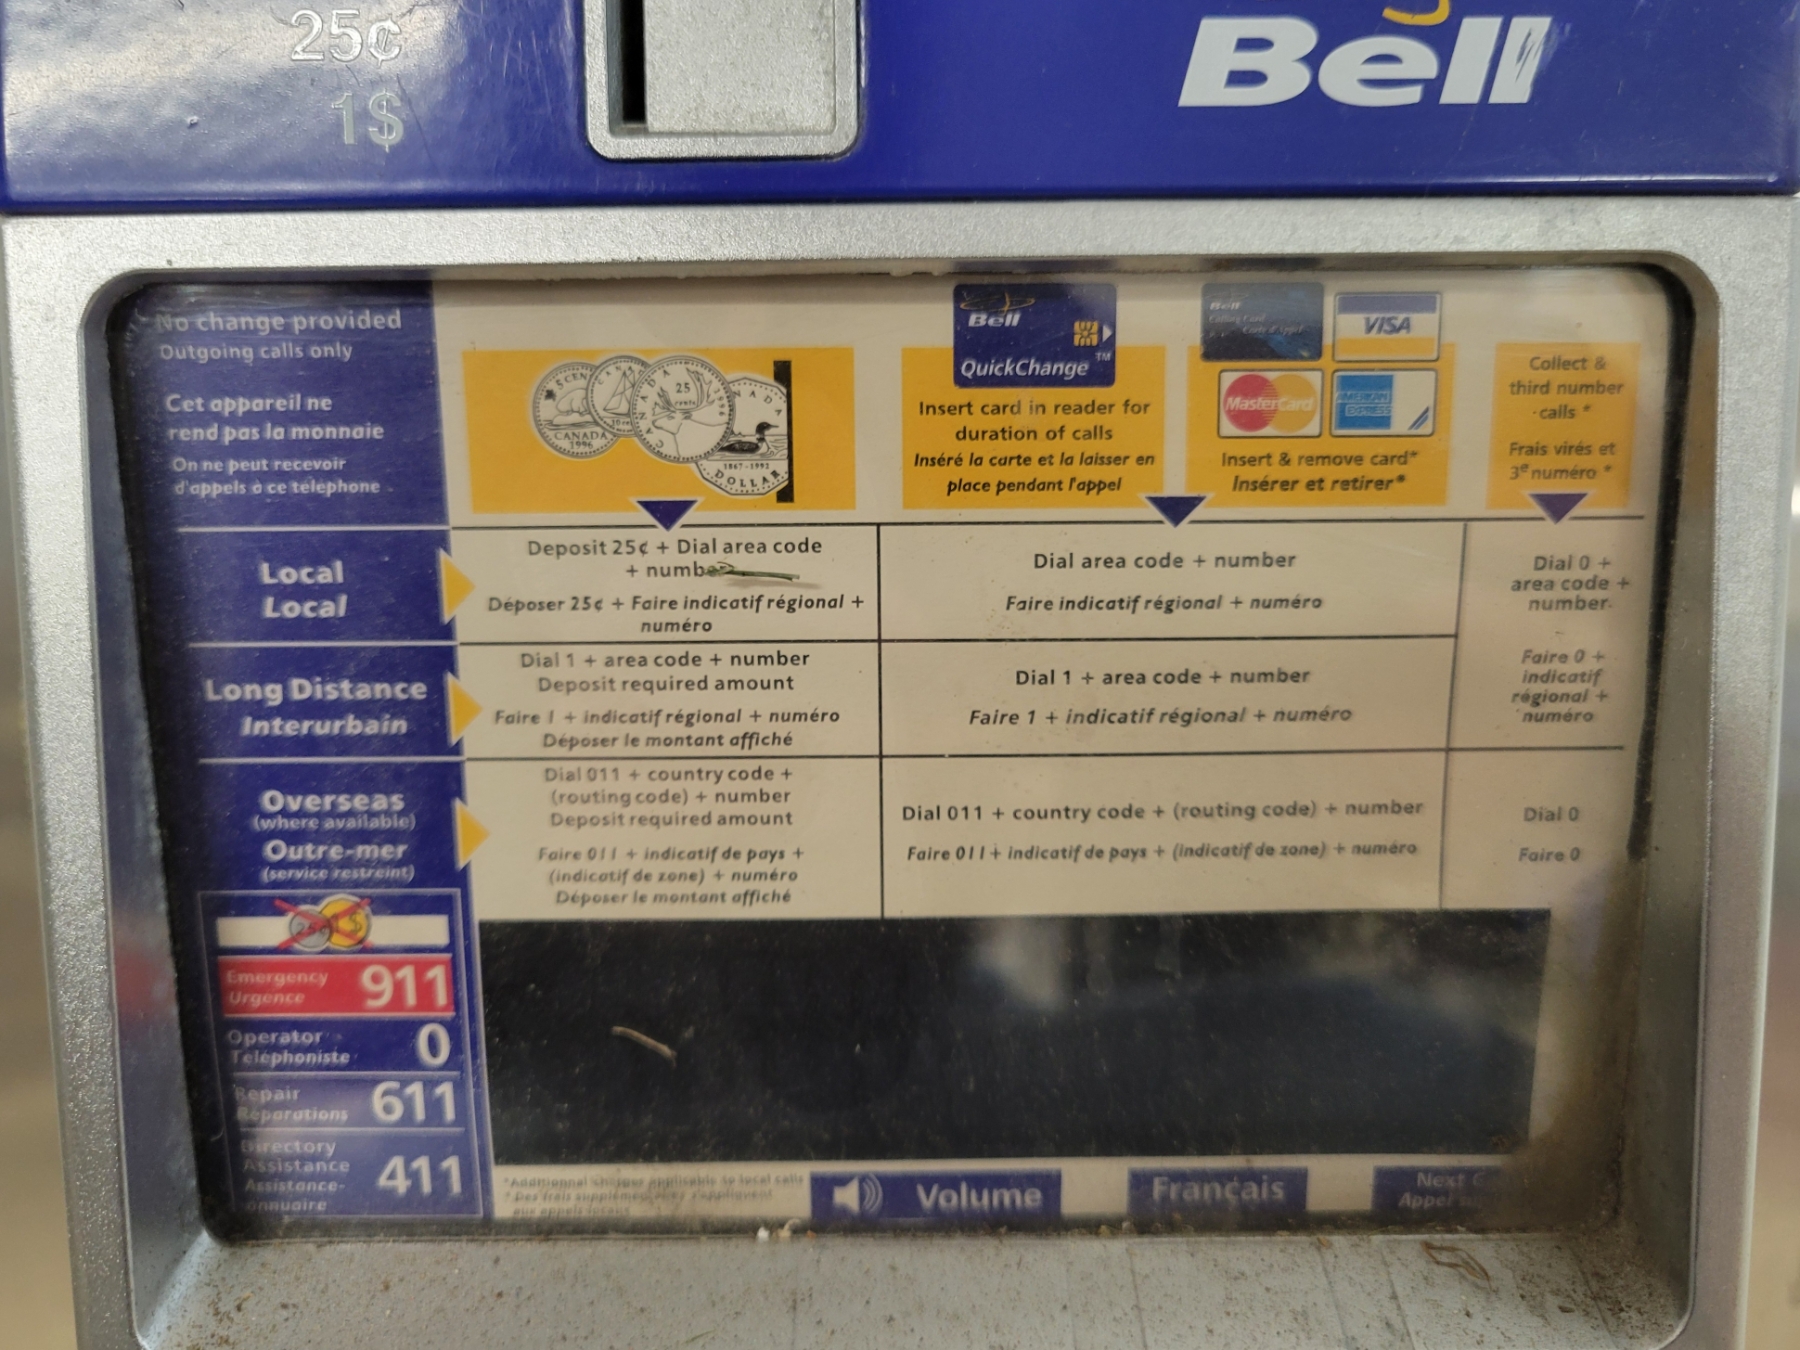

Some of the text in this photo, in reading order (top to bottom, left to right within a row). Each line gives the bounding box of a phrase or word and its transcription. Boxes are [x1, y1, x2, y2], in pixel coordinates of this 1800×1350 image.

[292, 9, 401, 68] 25¢
[1178, 16, 1553, 107] Bell
[331, 88, 404, 153] 1$
[157, 310, 401, 335] No change provided
[968, 313, 1021, 327] Bell
[1364, 317, 1411, 334] VISA
[160, 342, 352, 366] Outgoing calls only
[1529, 356, 1606, 370] Collect &
[961, 358, 1089, 380] QuickChange
[676, 383, 690, 393] 25
[1509, 380, 1624, 395] third number
[166, 394, 332, 416] Cet appareil ne
[919, 399, 1150, 416] Insert card in reader for
[1225, 397, 1314, 411] MasterCard
[1539, 405, 1576, 419] calls
[169, 423, 384, 444] rend pas la monnaie
[554, 431, 609, 440] CANADA
[955, 426, 1113, 441] duration of calls
[570, 440, 594, 450] 1996
[1509, 441, 1616, 456] Frais virés et
[173, 458, 346, 474] On ne peut recevoir
[914, 452, 1155, 467] Inséré la carte et la laisser en
[1222, 453, 1272, 467] Insert
[1279, 453, 1291, 466] &
[1298, 454, 1363, 466] remove
[715, 470, 780, 487] DOLLAR
[947, 477, 1122, 496] place pendant l'appel
[1232, 475, 1299, 491] Insérer
[1306, 477, 1324, 491] et
[174, 480, 246, 498] d'appels
[252, 479, 262, 494] à
[268, 482, 287, 494] ce
[528, 538, 822, 560] Deposit 25¢ + Dial area code
[1033, 552, 1296, 569] Dial area code + number
[260, 560, 344, 584] Local
[626, 565, 638, 578] +
[263, 594, 347, 618] Local
[489, 594, 864, 615] Déposer 25¢ + Faire indicatif régional +
[1006, 594, 1322, 614] Faire indicatif régional + numéro
[641, 618, 712, 633] numéro
[539, 676, 795, 695] Deposit required amount
[1015, 669, 1310, 685] Dial 1 + area code + number
[205, 677, 427, 706] Long Distance
[241, 715, 408, 736] Interurbain
[543, 732, 793, 750] Déposer le montant affiché
[260, 790, 405, 811] Overseas
[551, 812, 793, 830] Deposit required amount
[902, 801, 1423, 823] Dial 011 + country code + (routing code) + number
[1524, 806, 1579, 822] Dial 0
[254, 814, 416, 831] (where available)
[263, 840, 408, 862] Outre-mer
[1518, 847, 1580, 862] Faire 0
[261, 864, 415, 883] (service restreint)
[226, 970, 328, 988] Emergency
[361, 965, 447, 1007] 911
[229, 992, 305, 1006] Urgence
[228, 1030, 323, 1045] Operator
[417, 1022, 450, 1065] 0
[372, 1081, 455, 1122] 611
[244, 1160, 350, 1173] Assistance
[377, 1155, 461, 1196] 411
[1417, 1172, 1465, 1188] Next
[917, 1180, 1043, 1213] Volume
